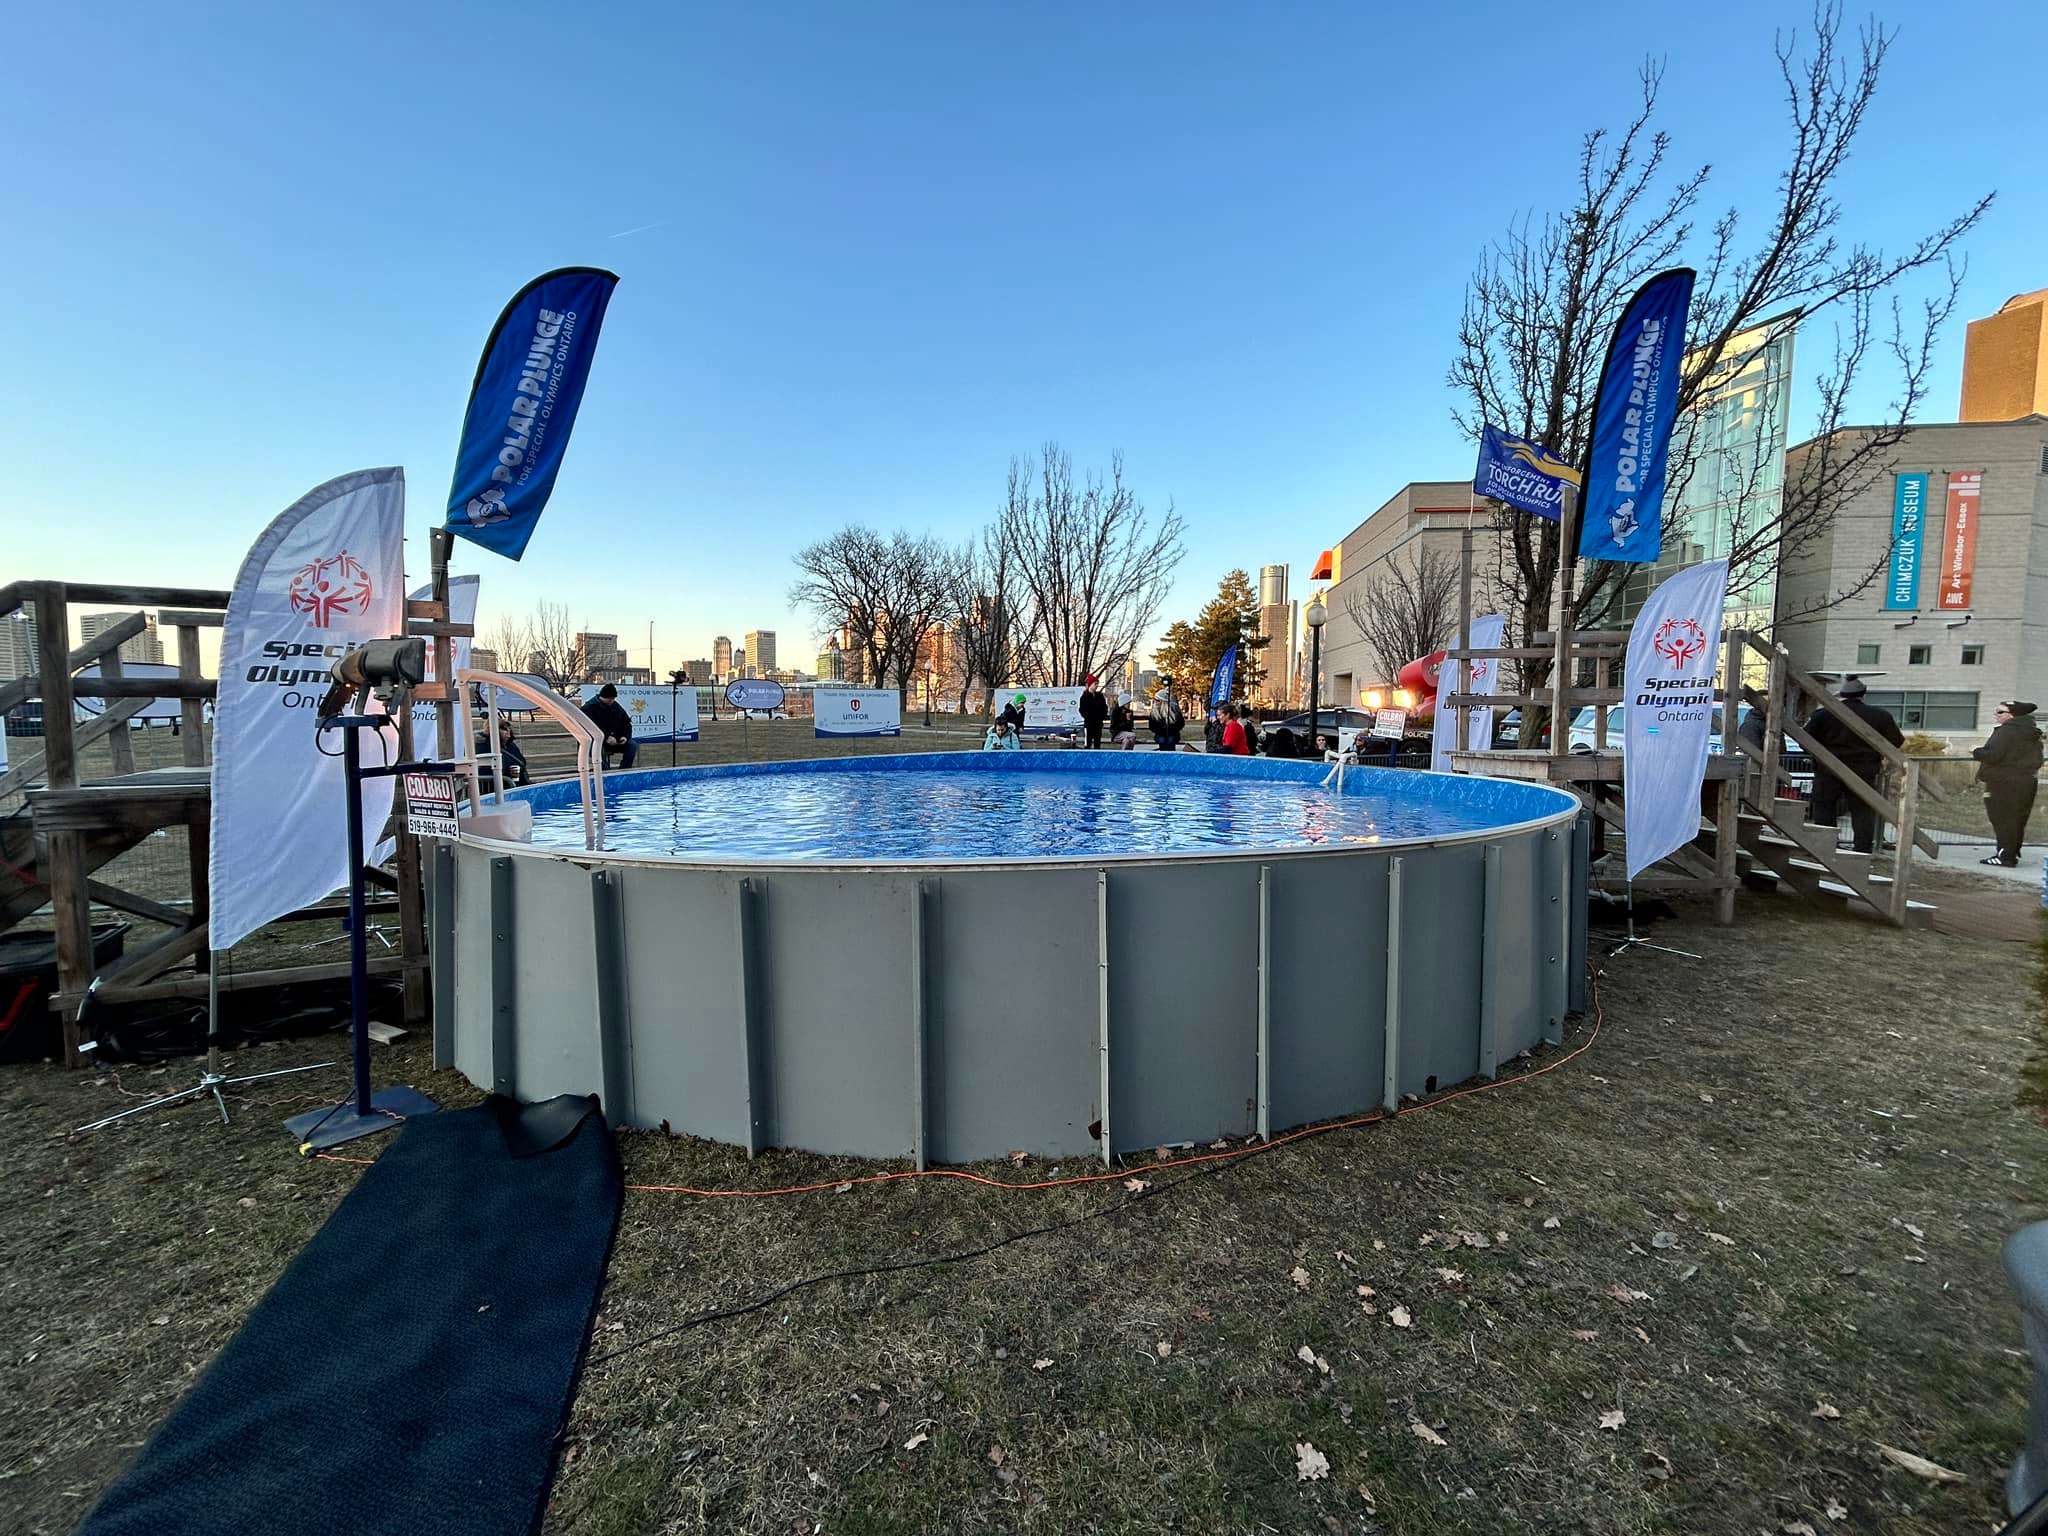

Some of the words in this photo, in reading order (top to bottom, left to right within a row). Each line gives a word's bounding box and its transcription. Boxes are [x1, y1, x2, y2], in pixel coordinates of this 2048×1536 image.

[1652, 316, 1668, 368] ONTAO
[1628, 318, 1660, 406] PLUNGE
[491, 396, 540, 484] POLAR
[517, 308, 565, 398] PLUNGE
[516, 465, 534, 486] FOR
[526, 421, 548, 465] SPECIAL
[541, 362, 564, 419] OLYMPICS
[556, 311, 577, 362] ONTARIO
[1644, 368, 1660, 423] OLYMPICS
[1615, 407, 1643, 493] POLAR
[1640, 424, 1654, 467] SPECIAL
[1489, 464, 1535, 494] TORCH
[1516, 494, 1551, 509] OLYMPICS
[1901, 480, 1921, 532] MUSEUM
[1895, 538, 1916, 602] CHIMCZUK
[1945, 592, 1964, 604] AWE
[262, 640, 357, 661] Speci
[246, 665, 332, 687] Olym
[1644, 675, 1714, 692] Special
[1636, 692, 1709, 708] Olympic
[630, 714, 667, 724] CLAIR
[1657, 709, 1704, 722] Ontario
[407, 776, 451, 800] COLBRO
[409, 819, 457, 837] 519-966-4442
